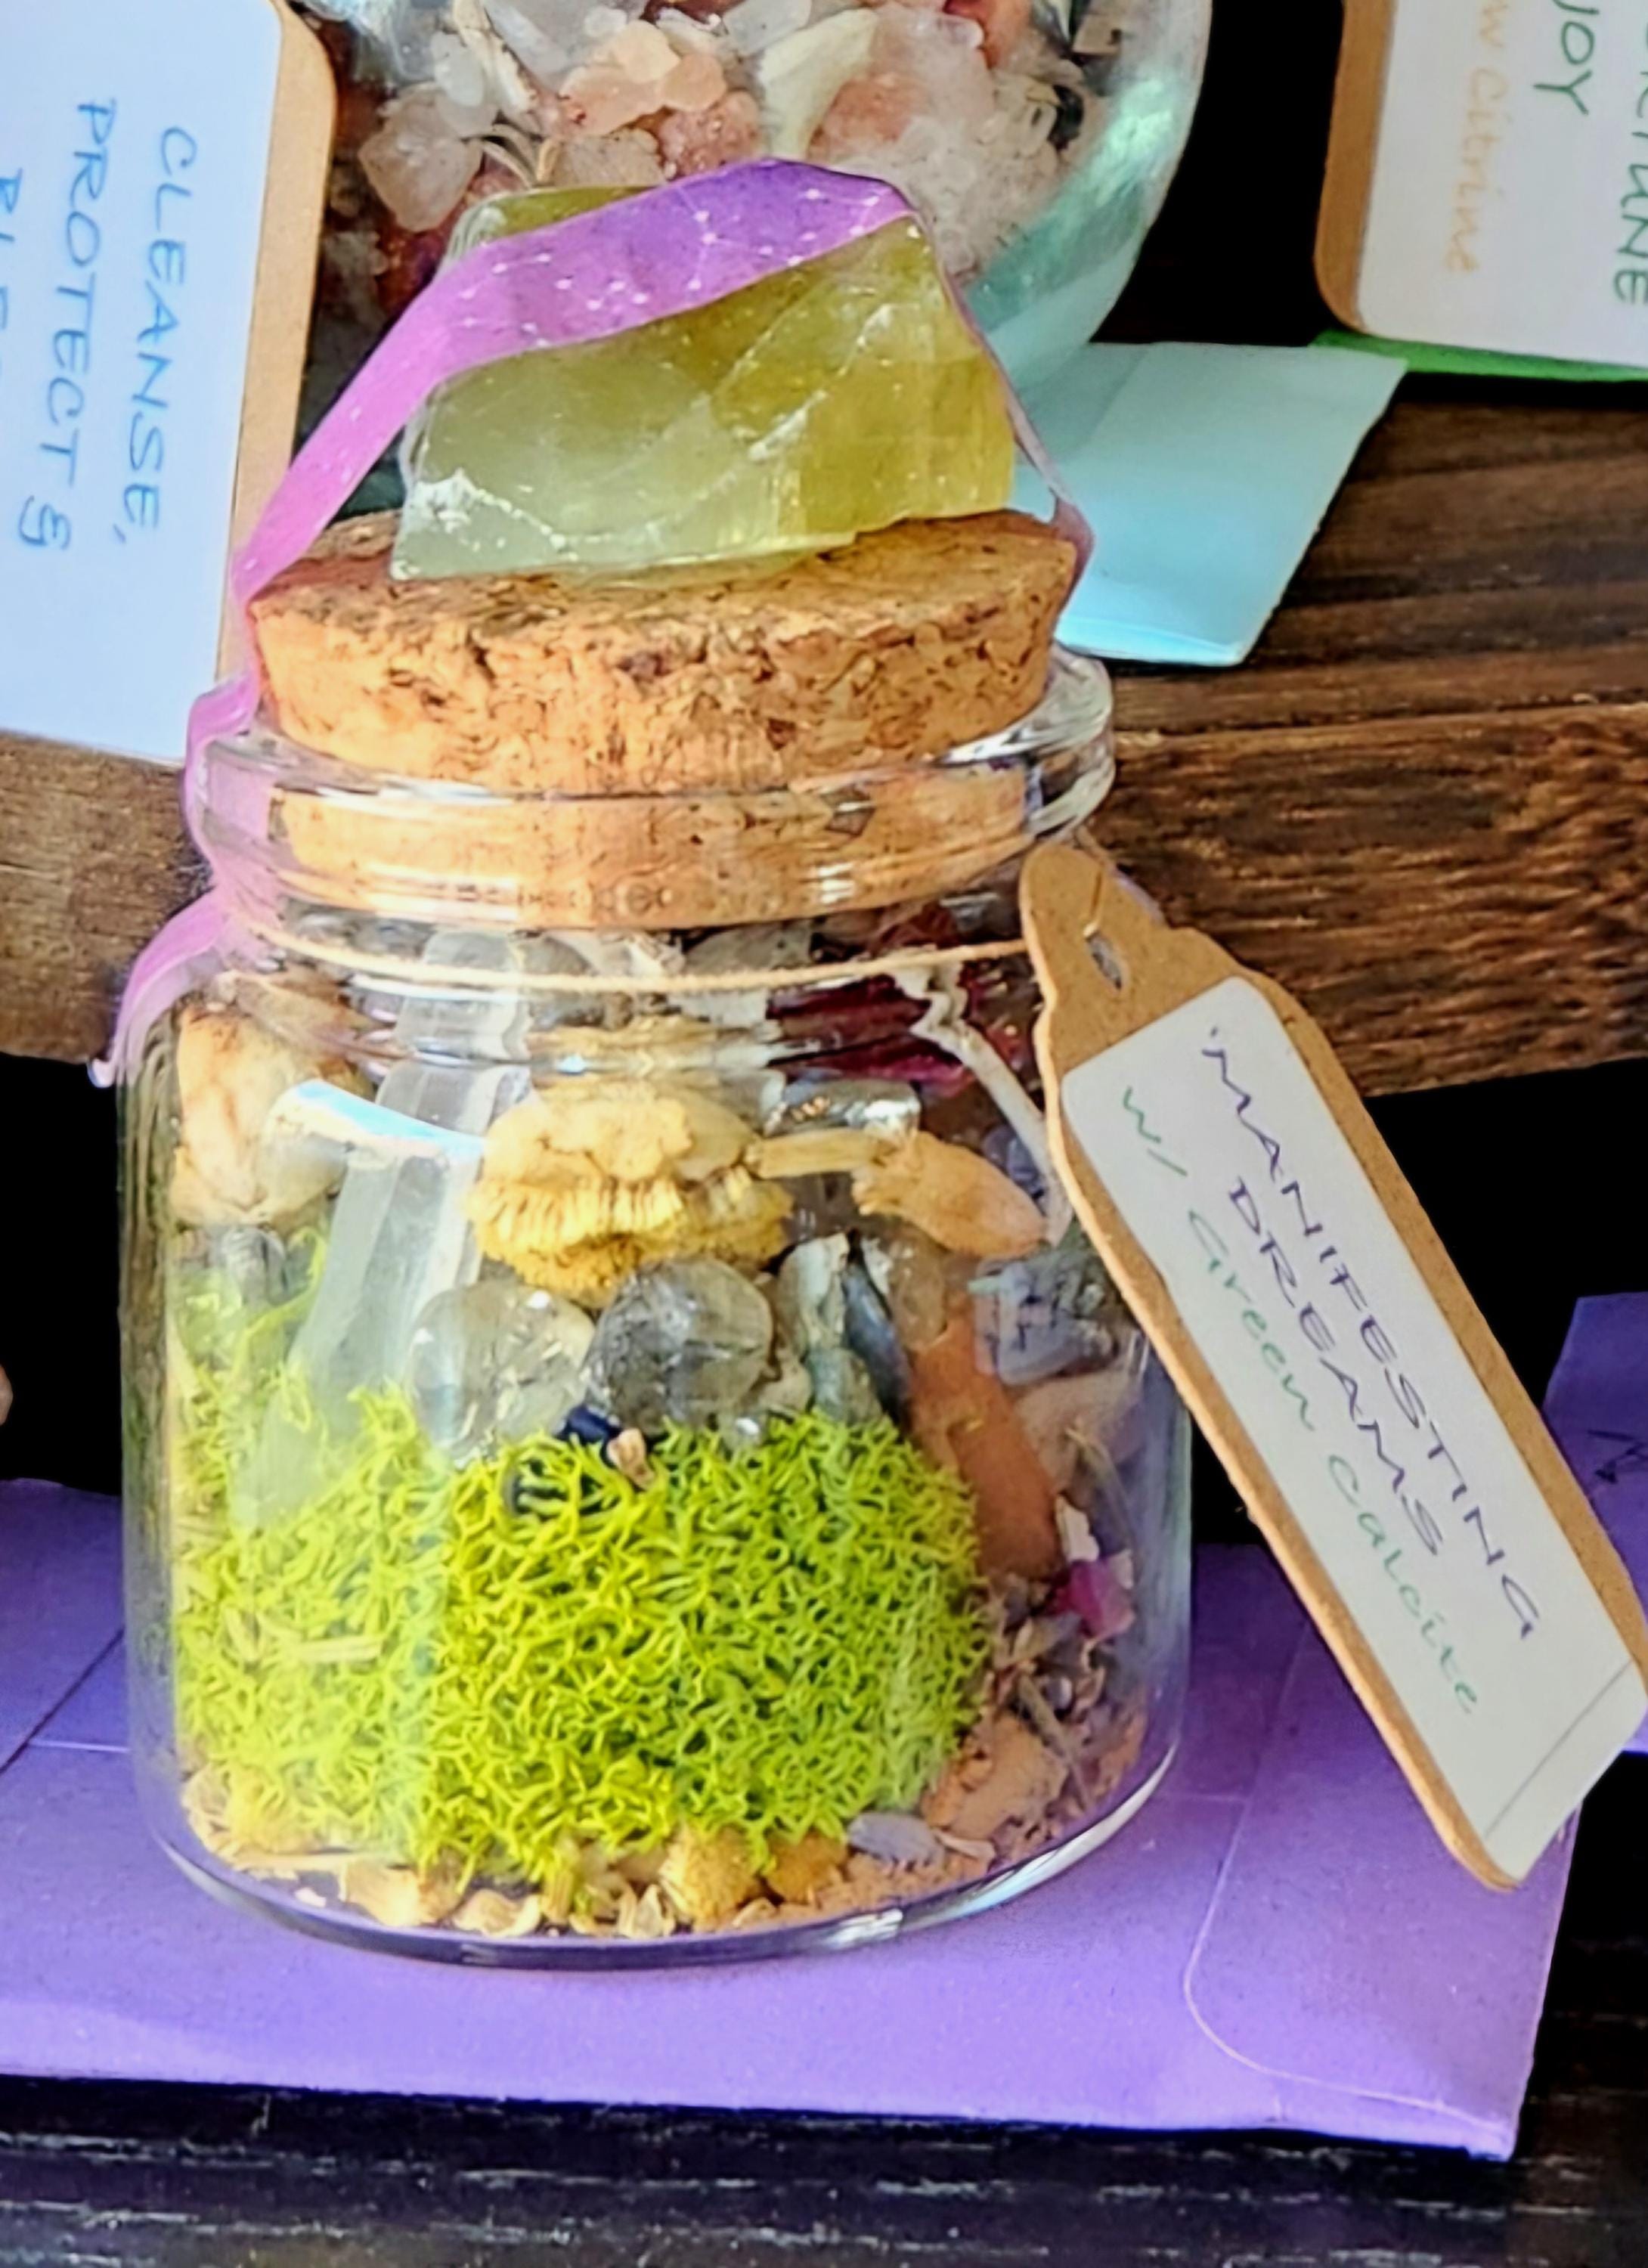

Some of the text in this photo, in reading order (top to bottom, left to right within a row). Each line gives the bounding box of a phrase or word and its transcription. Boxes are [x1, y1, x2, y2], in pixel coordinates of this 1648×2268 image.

[1533, 0, 1600, 116] JOY
[39, 98, 116, 487] PROTECT
[113, 126, 197, 544] CLEANSE,
[1187, 1210, 1317, 1433] Green
[1228, 1175, 1444, 1557] DREAMS
